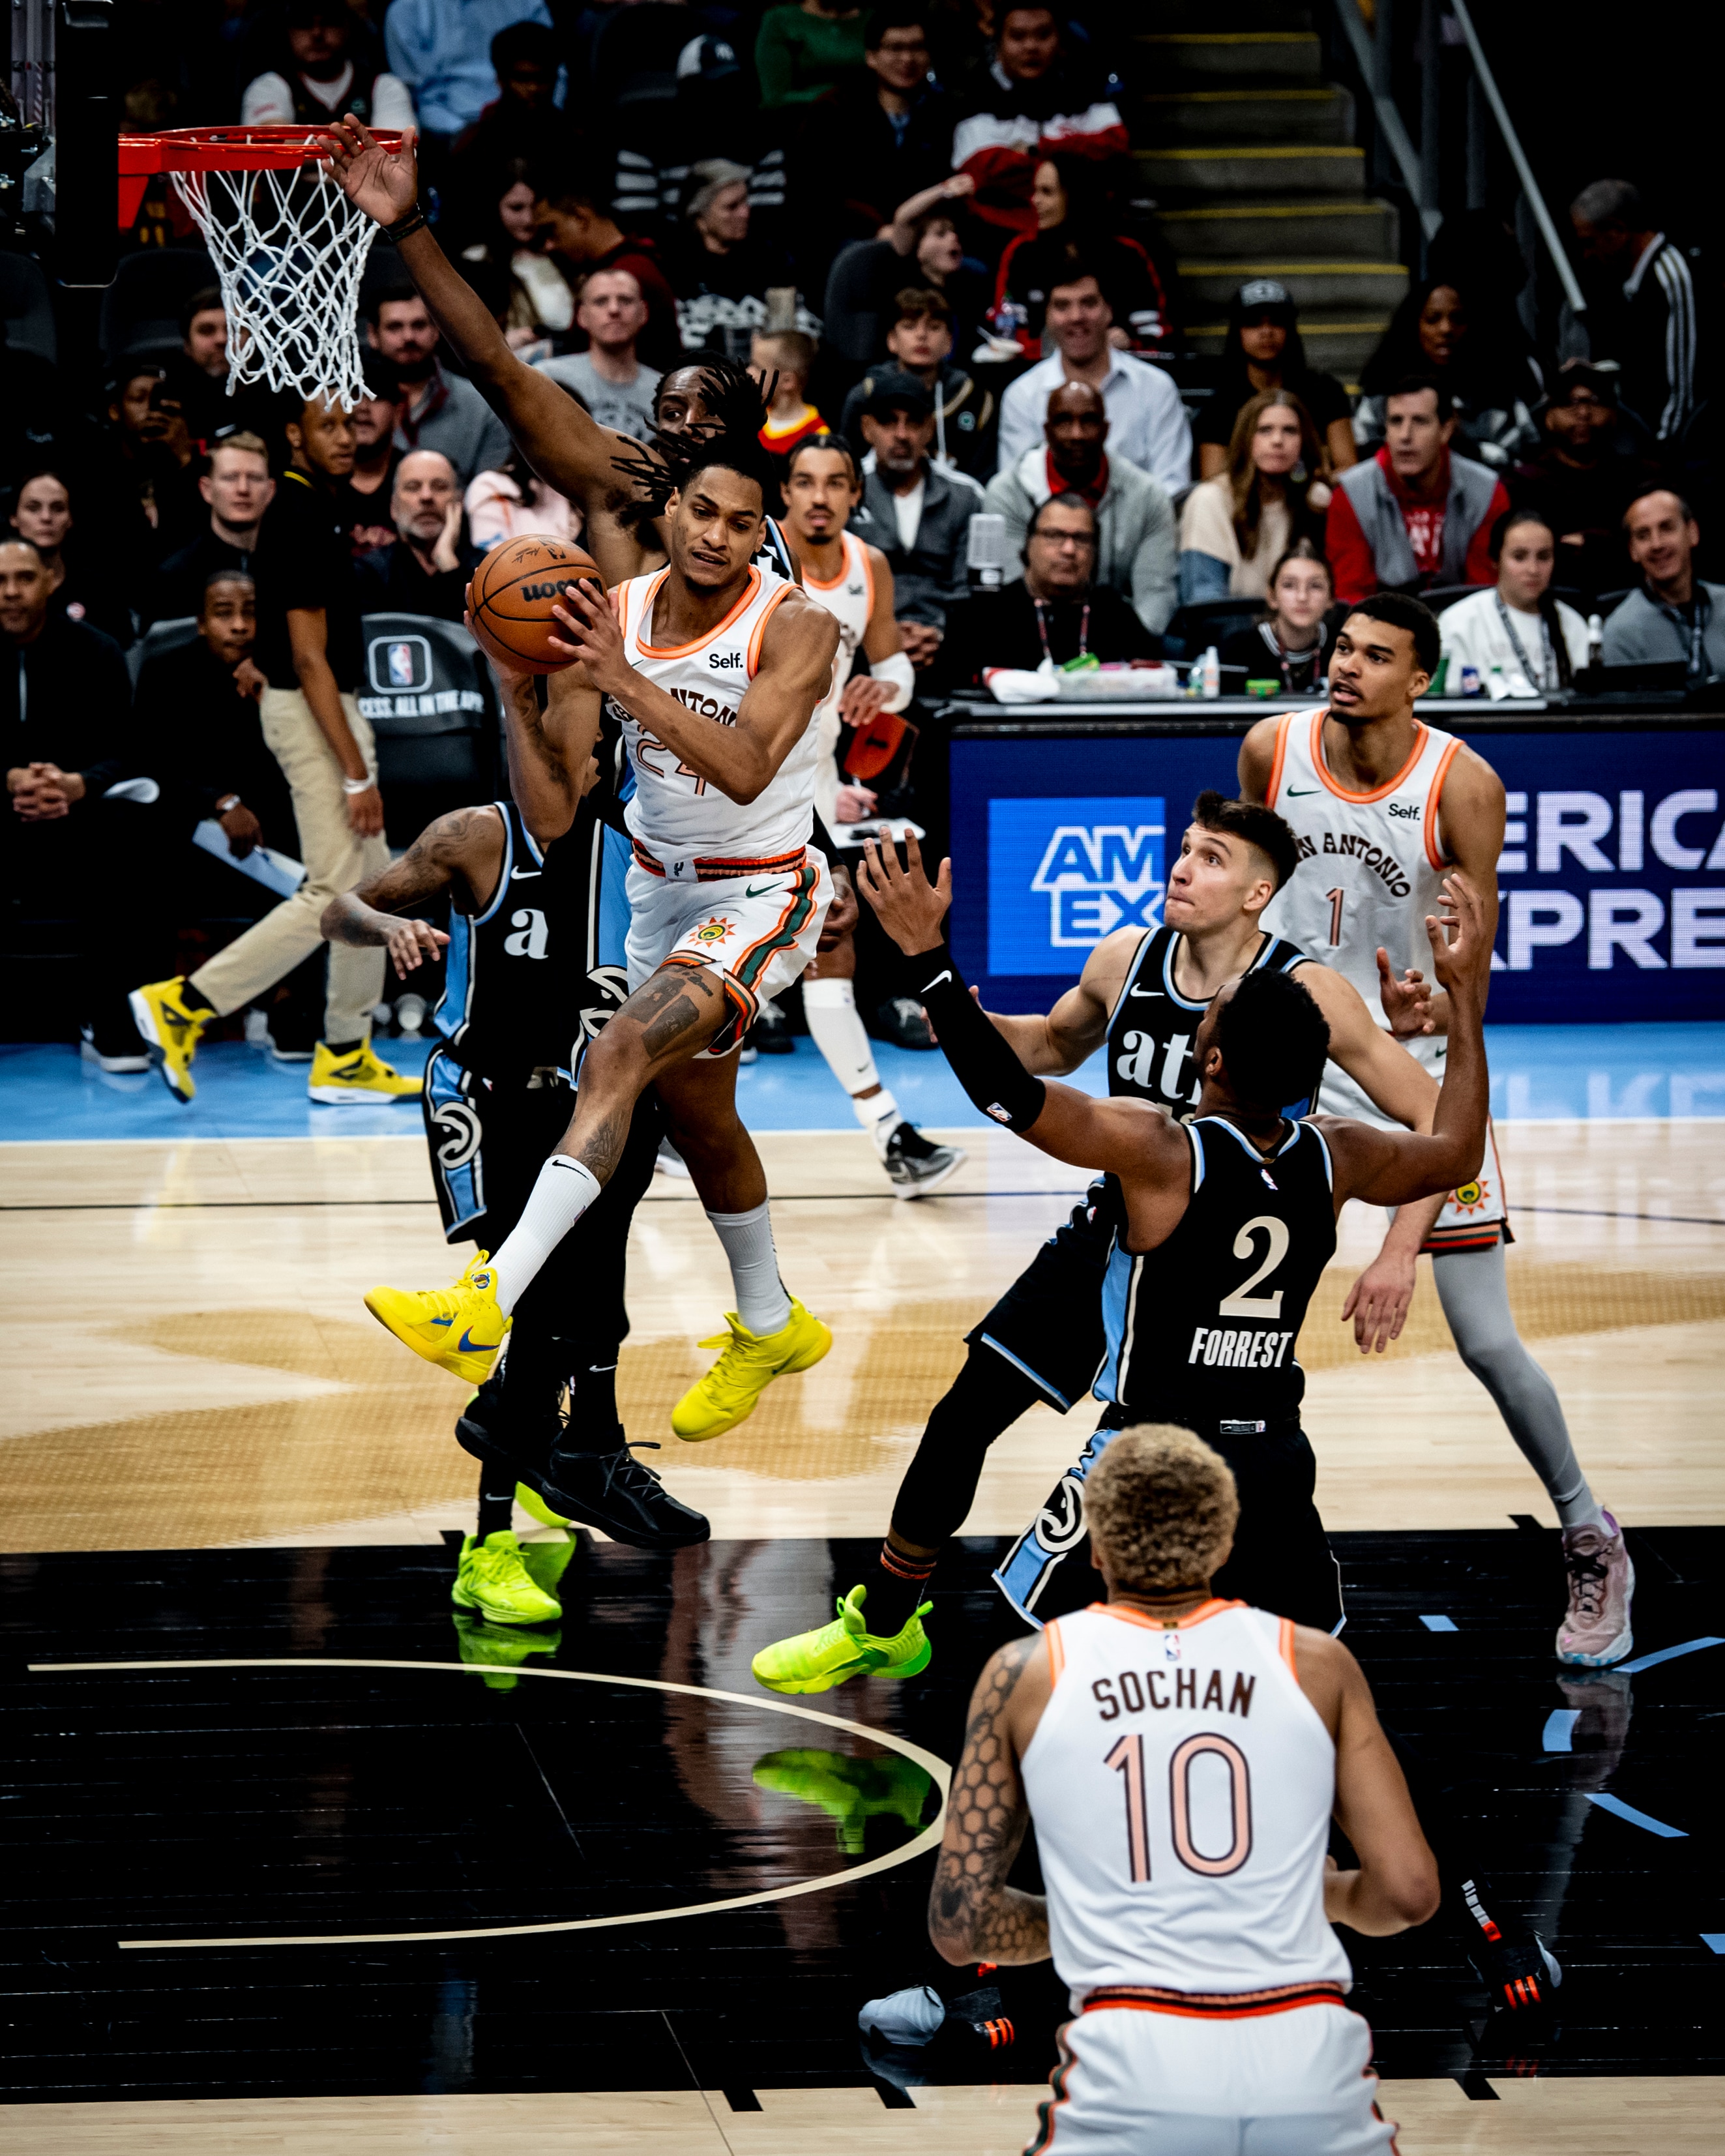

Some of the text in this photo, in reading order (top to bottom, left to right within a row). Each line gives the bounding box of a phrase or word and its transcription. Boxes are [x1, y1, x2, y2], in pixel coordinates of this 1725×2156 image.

[709, 653, 744, 669] Self.
[670, 688, 738, 728] NTON
[1388, 803, 1421, 820] Self.
[1496, 789, 1725, 874] RIC
[1031, 825, 1166, 892] AM
[1296, 832, 1411, 898] N ANTONIO
[1326, 887, 1344, 947] 1
[1490, 887, 1725, 971] PRE
[1218, 1216, 1290, 1319] 2
[1188, 1327, 1293, 1368] FORREST
[1091, 1668, 1256, 1721] SOCHAN
[1103, 1732, 1253, 1883] 10
